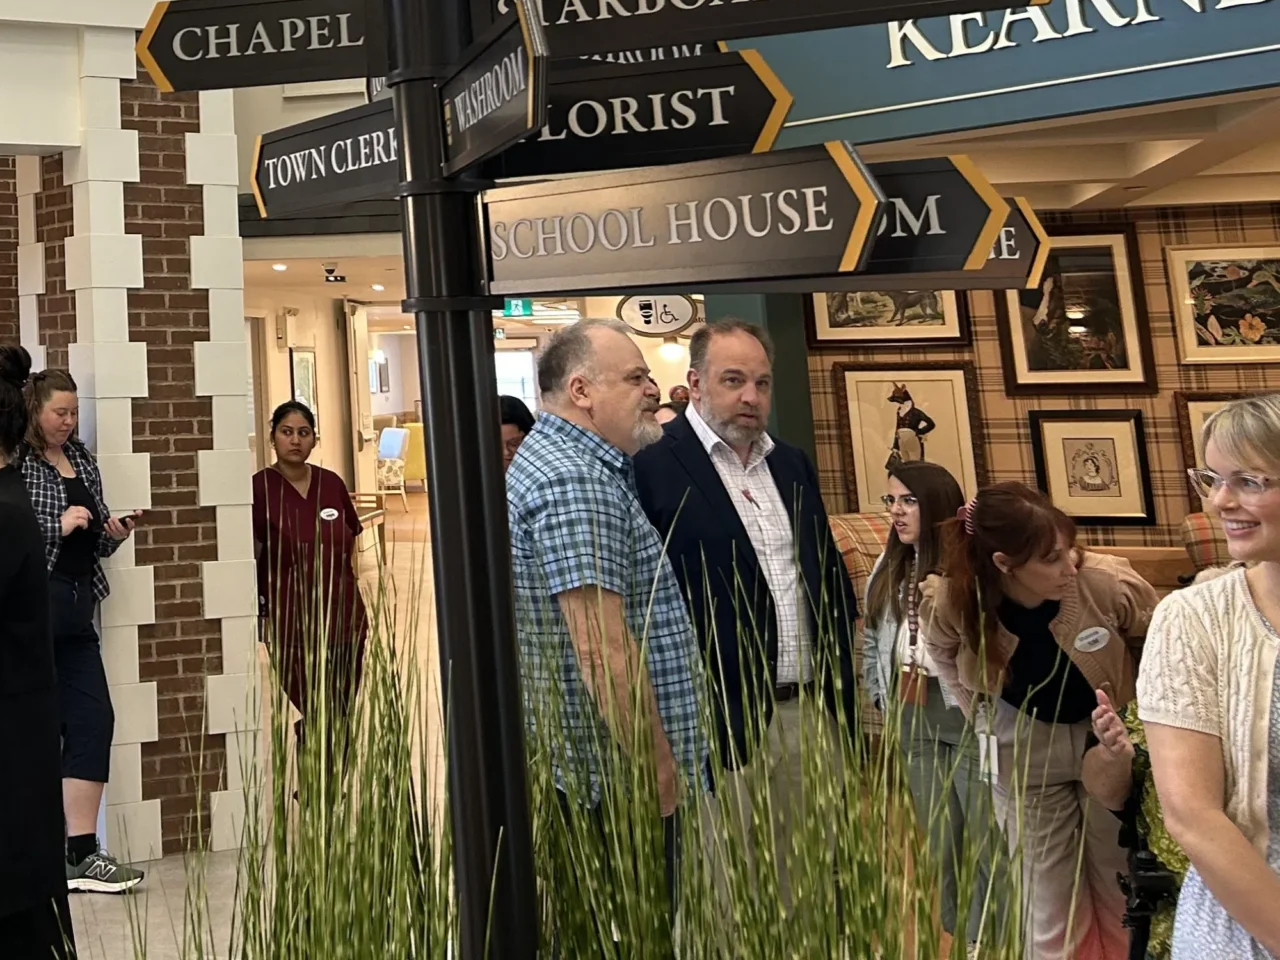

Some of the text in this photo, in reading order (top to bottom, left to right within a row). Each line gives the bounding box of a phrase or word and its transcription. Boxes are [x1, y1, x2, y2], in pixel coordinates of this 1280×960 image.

[172, 13, 365, 61] CHAPEL
[454, 46, 526, 133] WASHROOM
[518, 85, 735, 142] LORIST
[264, 145, 326, 189] TOWN
[490, 186, 835, 262] SCHOOL HOUSE
